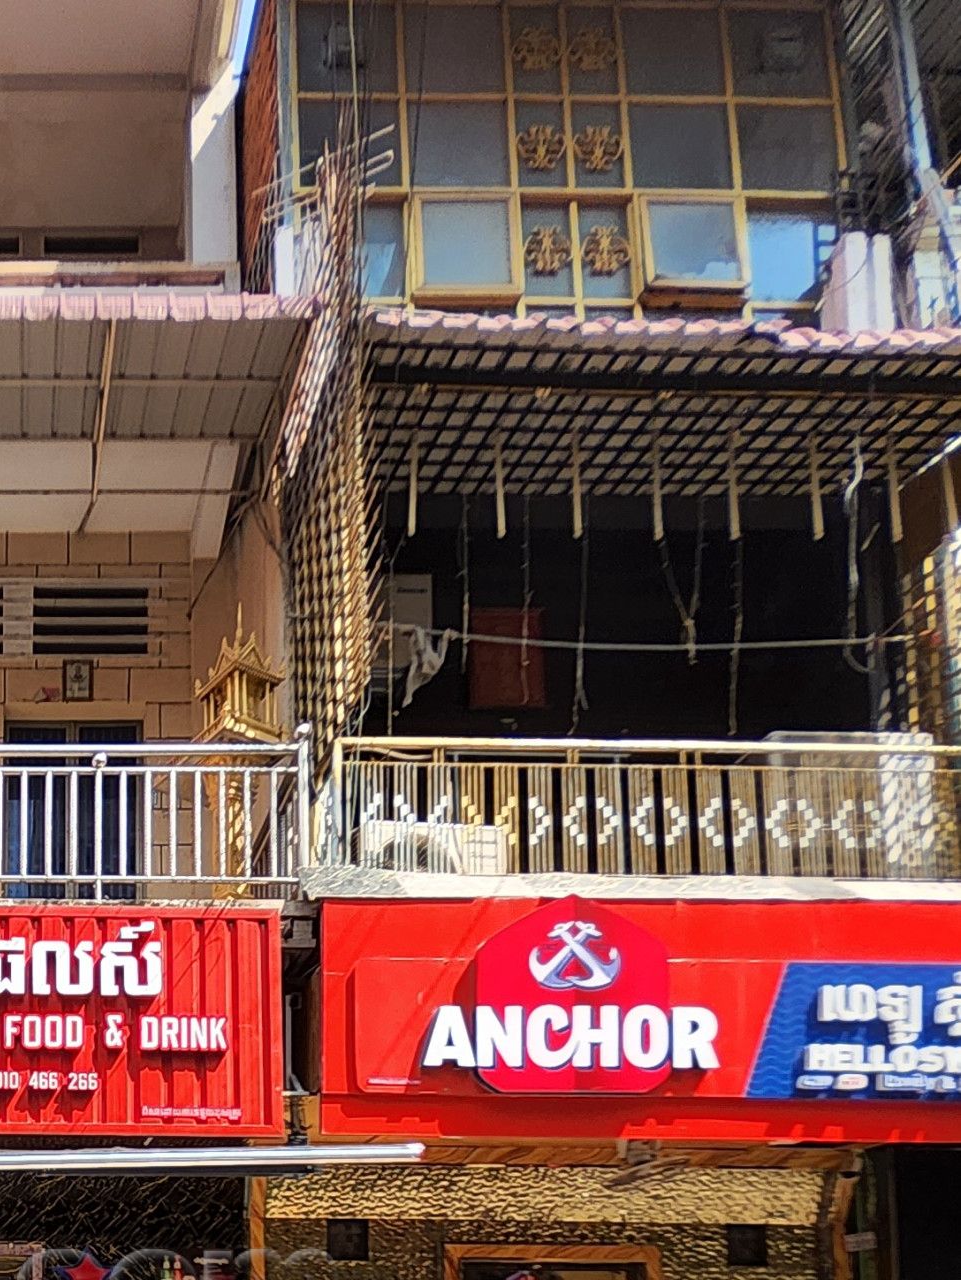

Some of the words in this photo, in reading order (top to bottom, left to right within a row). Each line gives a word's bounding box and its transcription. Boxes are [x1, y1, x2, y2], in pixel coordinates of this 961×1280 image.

[5, 1014, 85, 1049] FOOD
[105, 1013, 125, 1048] &
[139, 1015, 228, 1050] DRINK
[422, 1003, 722, 1071] ANCHOR
[28, 1071, 59, 1091] 466
[67, 1072, 99, 1092] 266
